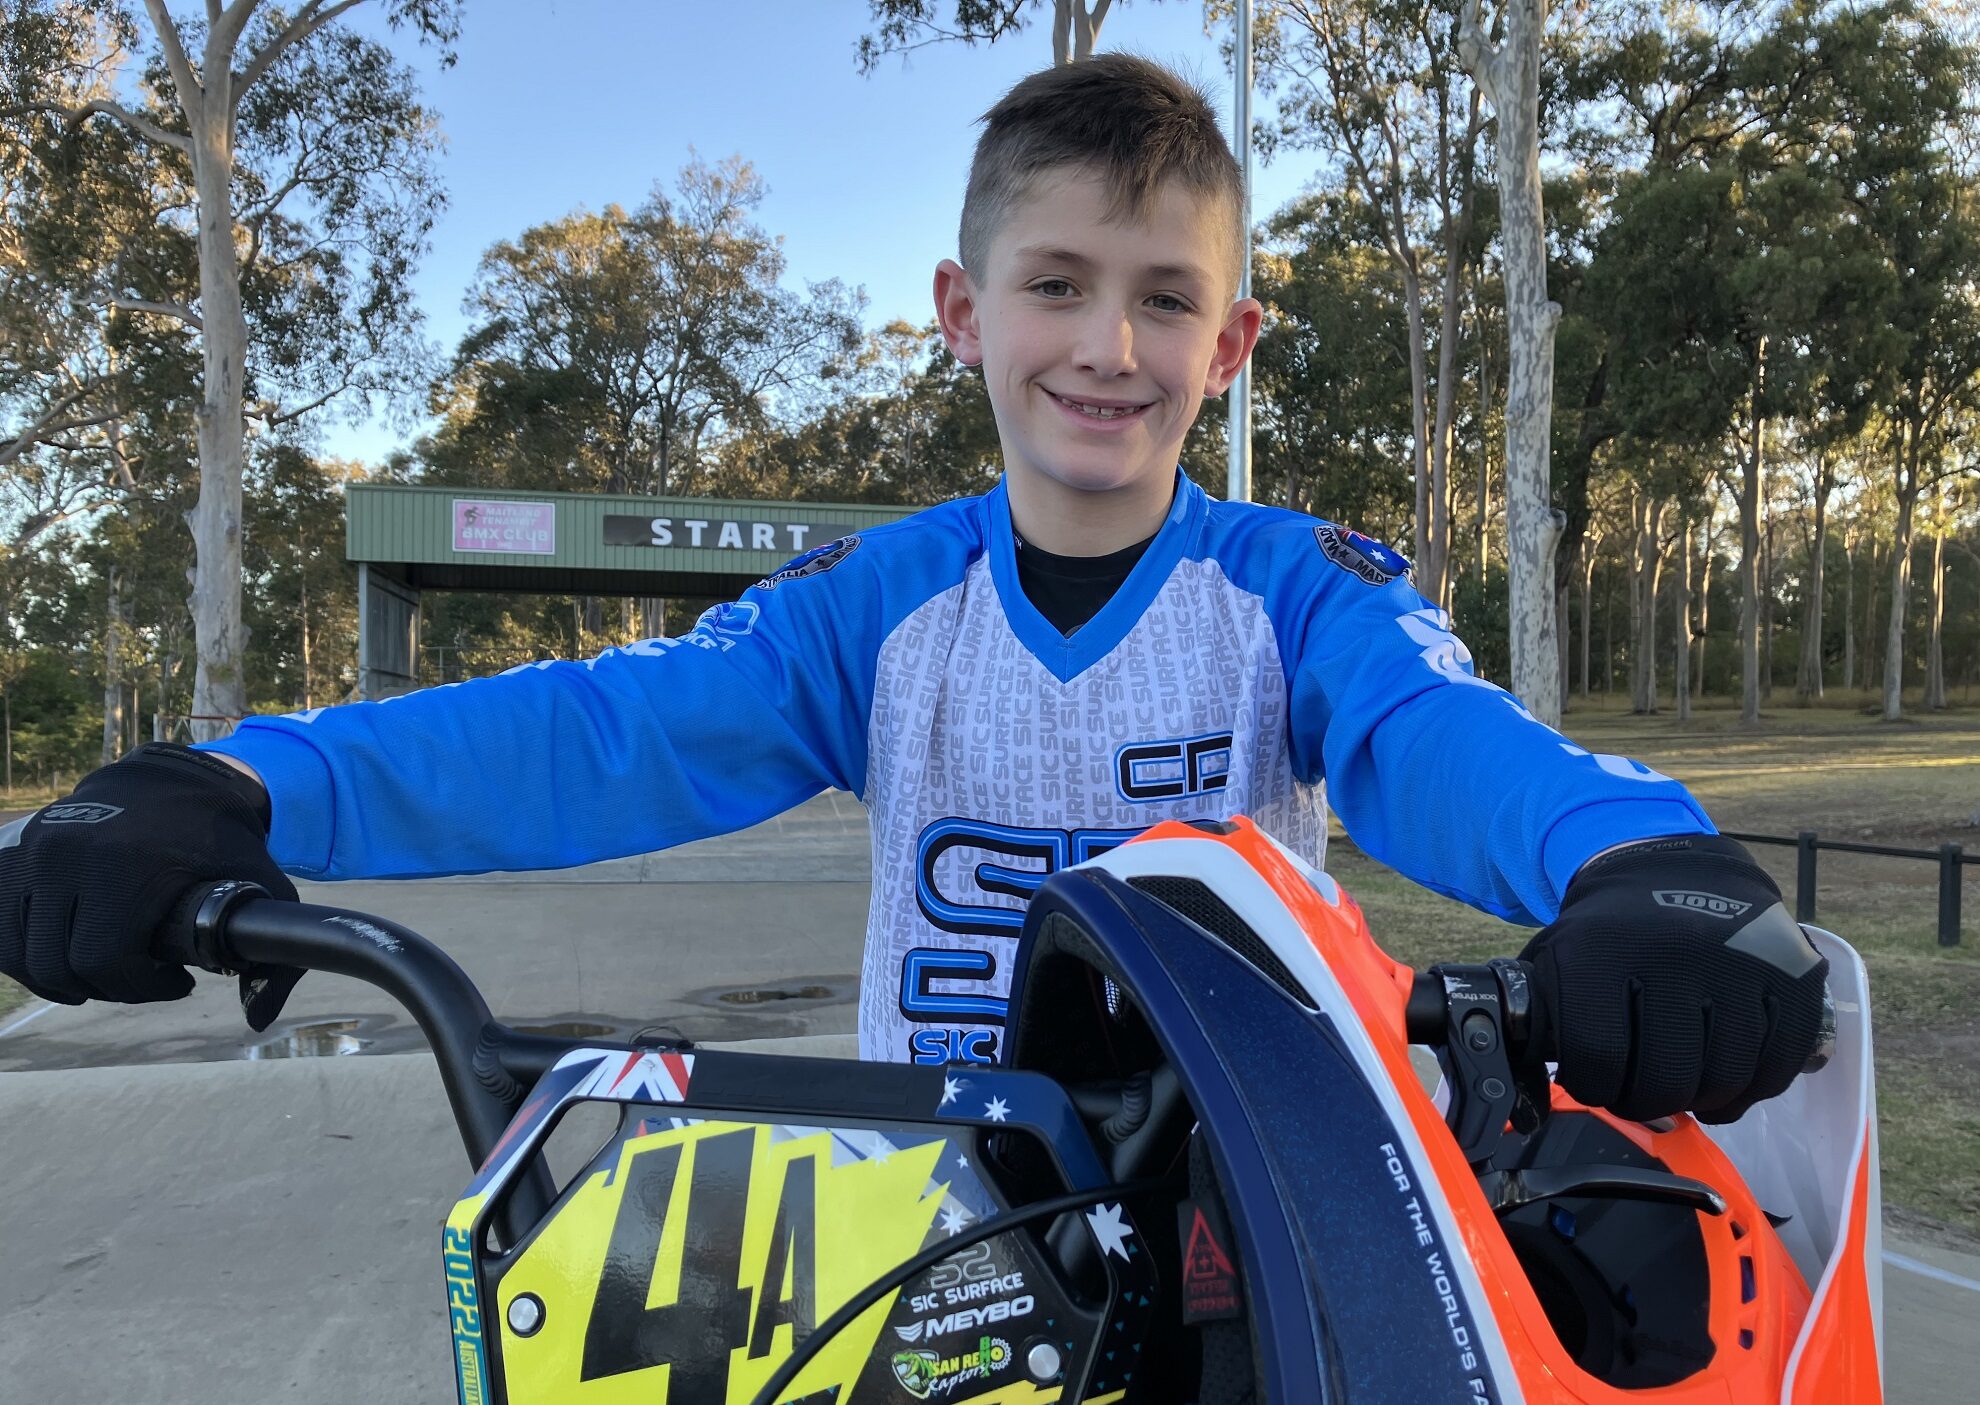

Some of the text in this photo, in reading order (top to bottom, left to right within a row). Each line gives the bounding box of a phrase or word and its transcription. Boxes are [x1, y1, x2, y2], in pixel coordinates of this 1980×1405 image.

[462, 527, 548, 542] BMX CLUB
[651, 518, 809, 551] START
[894, 651, 921, 700] SIC
[952, 576, 993, 726] SIC SURFACE
[974, 614, 1004, 724] SURFACE
[1147, 611, 1182, 714] SURFACE
[907, 604, 956, 762] SIC SURFACE
[992, 666, 1015, 780] SURFACE
[1014, 698, 1032, 746] SIC
[970, 726, 992, 774] SIC
[1088, 736, 1111, 784] SIC
[1254, 701, 1280, 810] SURFACE
[1041, 755, 1060, 802] SIC
[885, 766, 921, 882] SURFACE
[911, 1029, 996, 1065] SIC
[443, 1226, 482, 1336] 2022
[1380, 1142, 1411, 1192] FOR
[1405, 1196, 1434, 1247] THE
[1426, 1251, 1478, 1371] WORLD'S
[910, 1272, 1025, 1313] SIC SURFACE
[926, 1295, 1035, 1338] MEYBO
